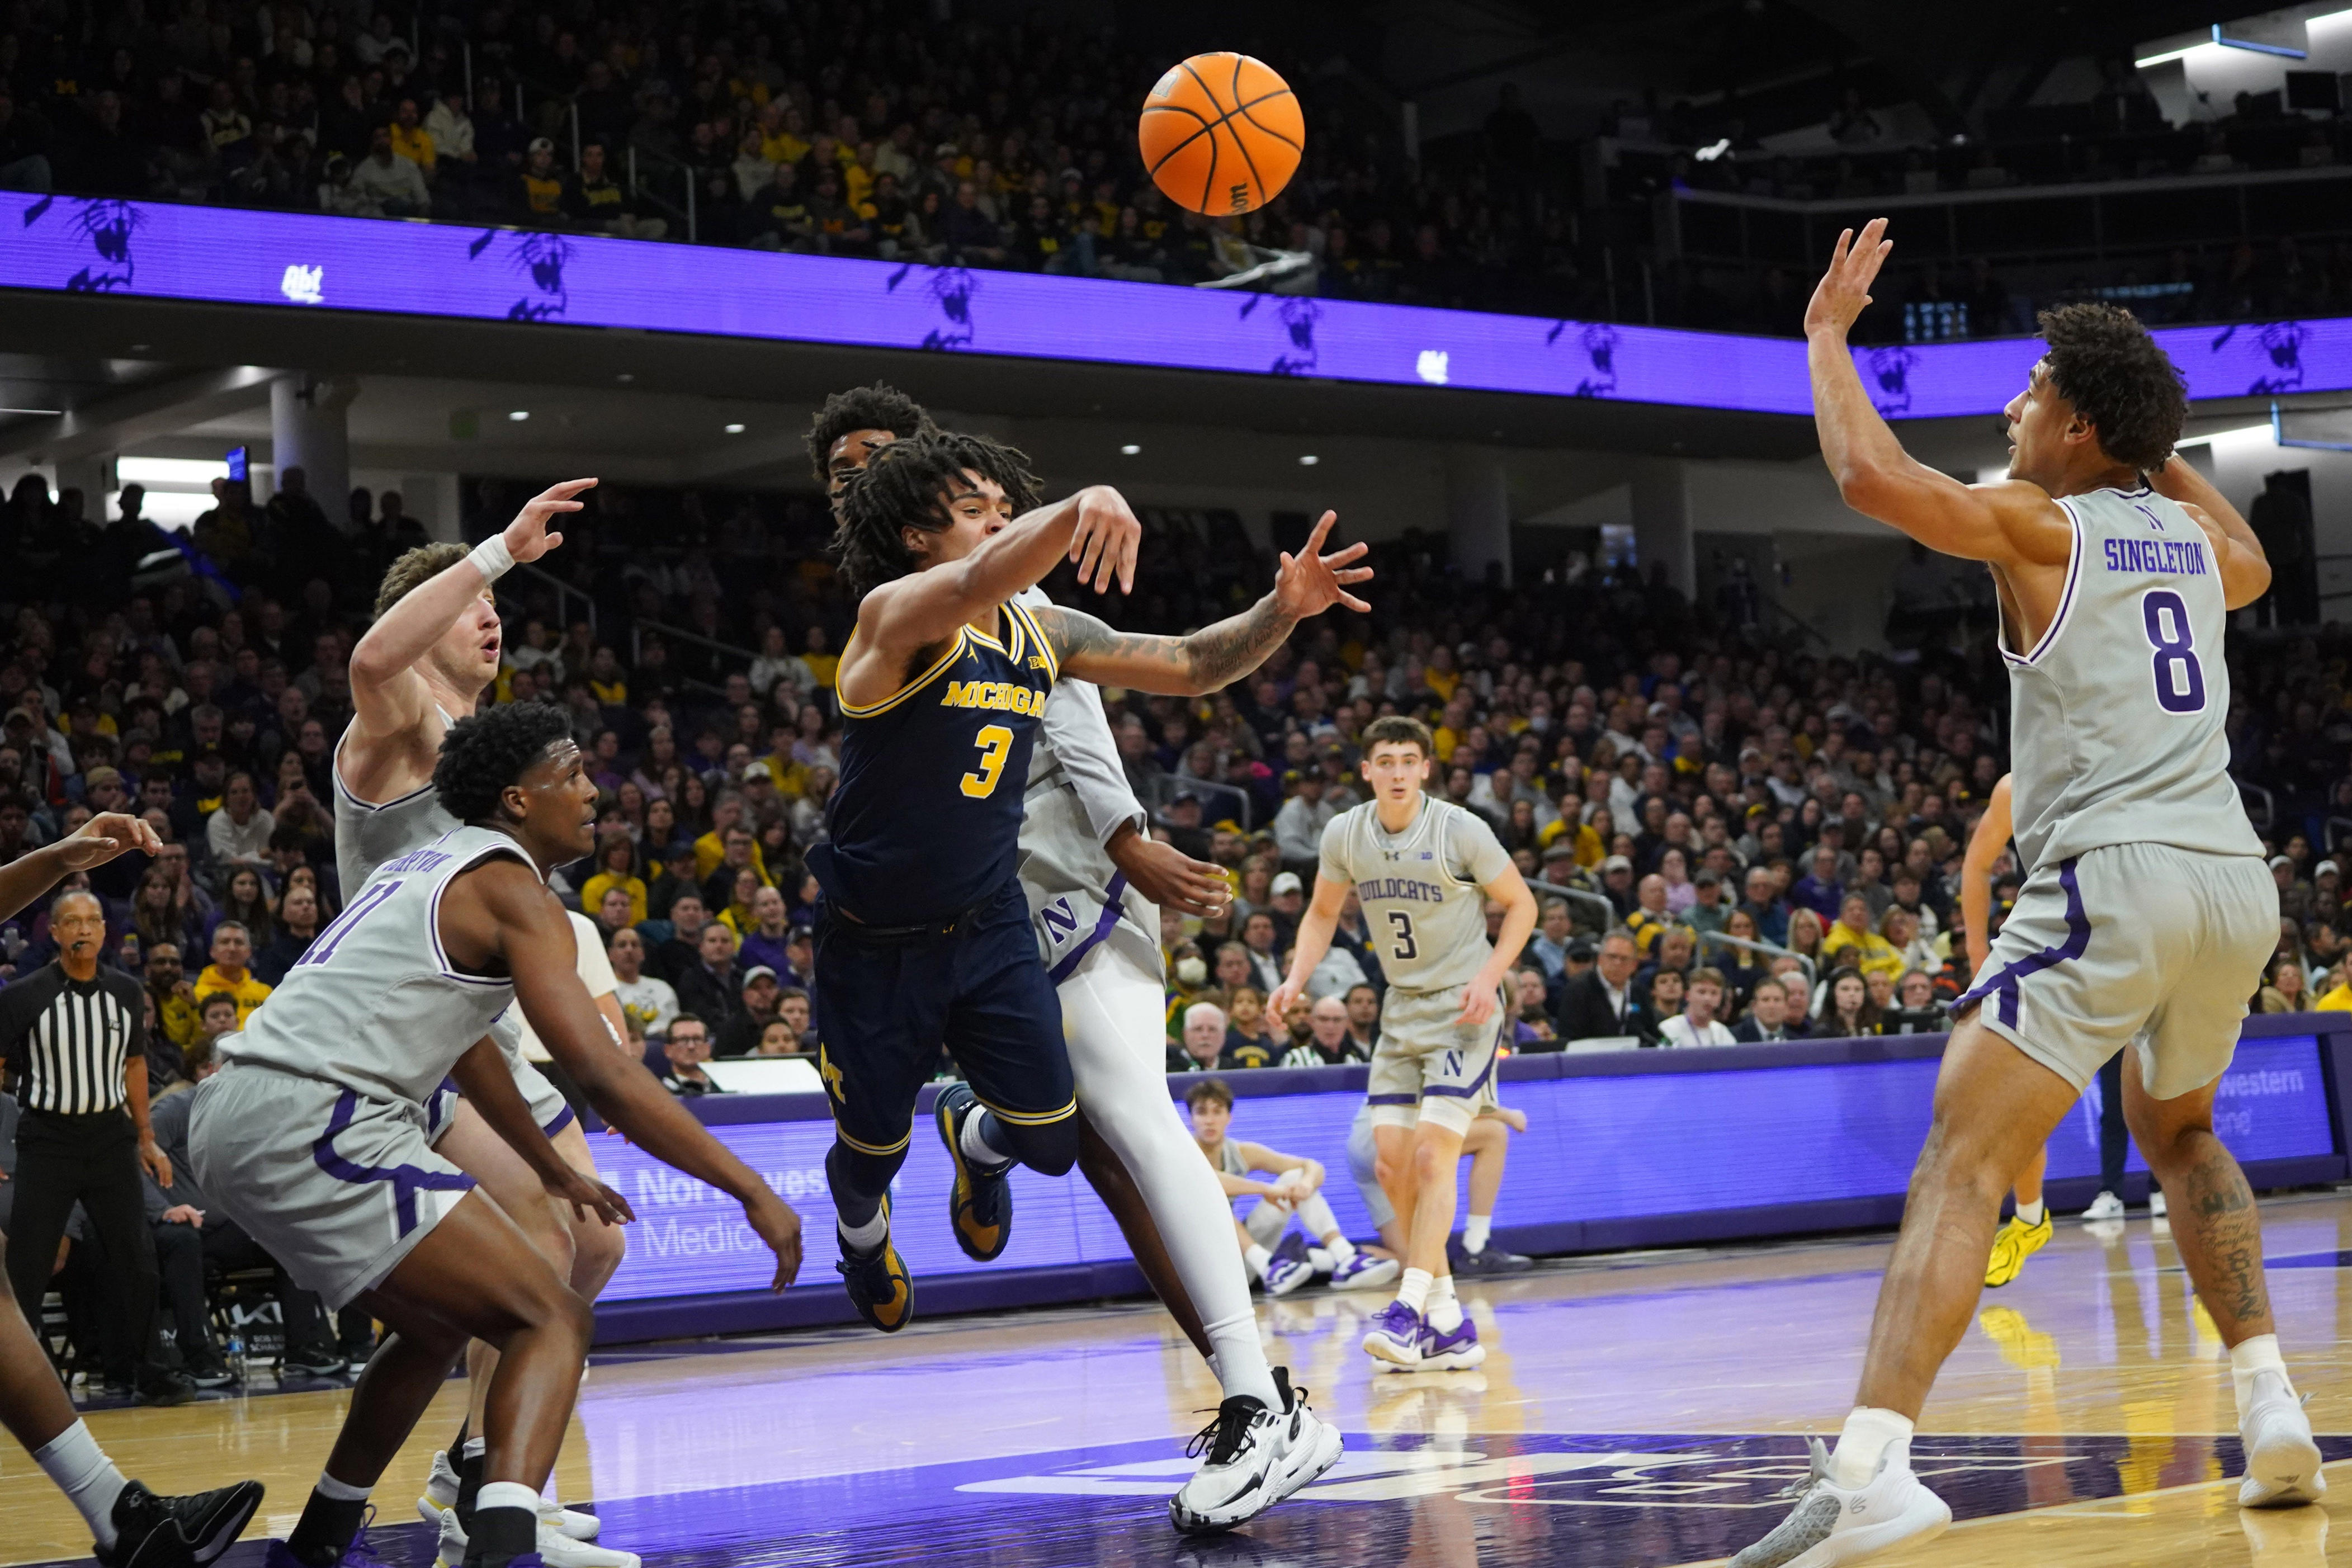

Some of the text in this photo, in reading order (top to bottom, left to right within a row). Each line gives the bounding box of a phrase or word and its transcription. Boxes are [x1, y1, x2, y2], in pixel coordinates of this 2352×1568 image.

[2104, 539, 2207, 575] SINGLETON
[2141, 587, 2208, 717] 8
[940, 681, 1046, 720] MICHIGA
[959, 724, 1014, 800] 3
[1359, 878, 1443, 902] WILDCATS
[291, 877, 411, 968] 11
[1039, 895, 1080, 947] N
[1387, 910, 1419, 960] 3
[1443, 1050, 1464, 1077] N
